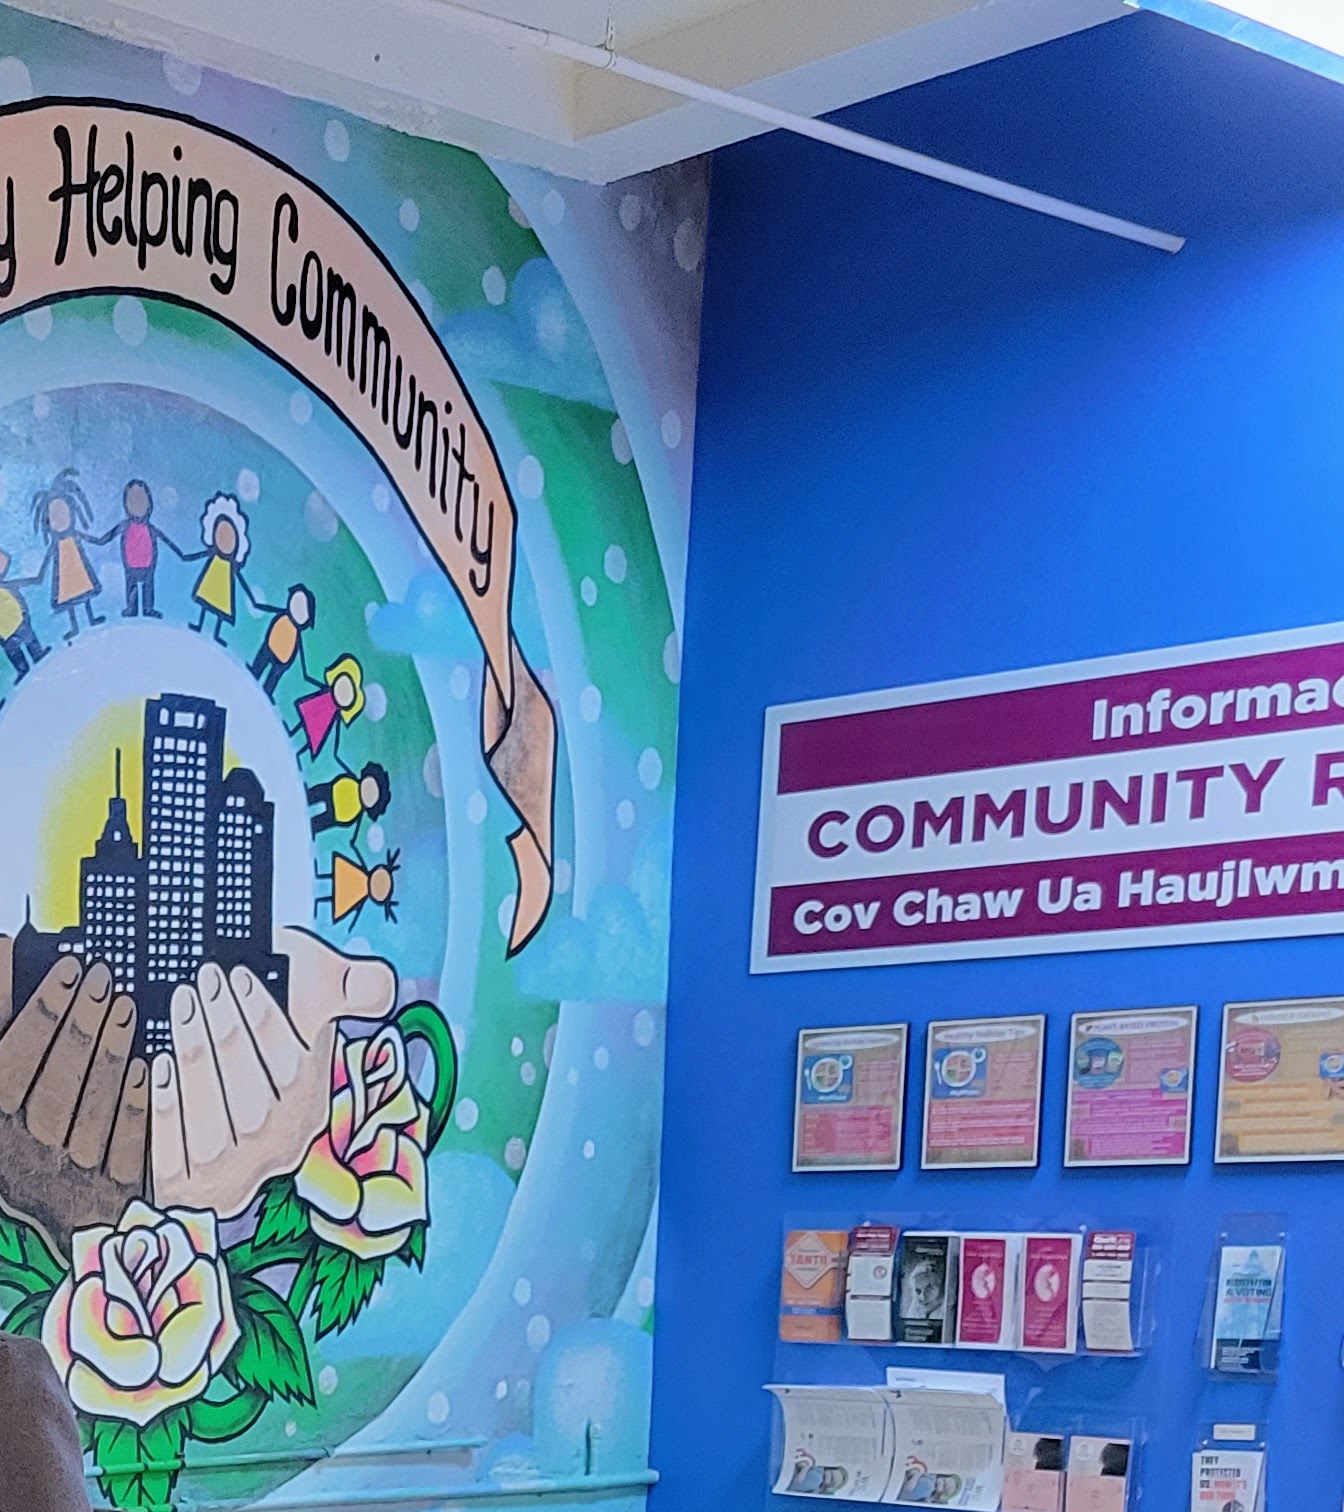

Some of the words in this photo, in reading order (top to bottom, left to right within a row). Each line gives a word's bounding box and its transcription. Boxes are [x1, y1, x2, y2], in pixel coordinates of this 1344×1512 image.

[48, 123, 240, 296] Helping
[269, 192, 497, 598] Community
[807, 757, 1286, 859] COMMUNITY
[793, 901, 881, 936] Cov
[893, 884, 1024, 928] Chaw
[1037, 876, 1102, 916] Ua
[1117, 857, 1344, 909] Haujlwm
